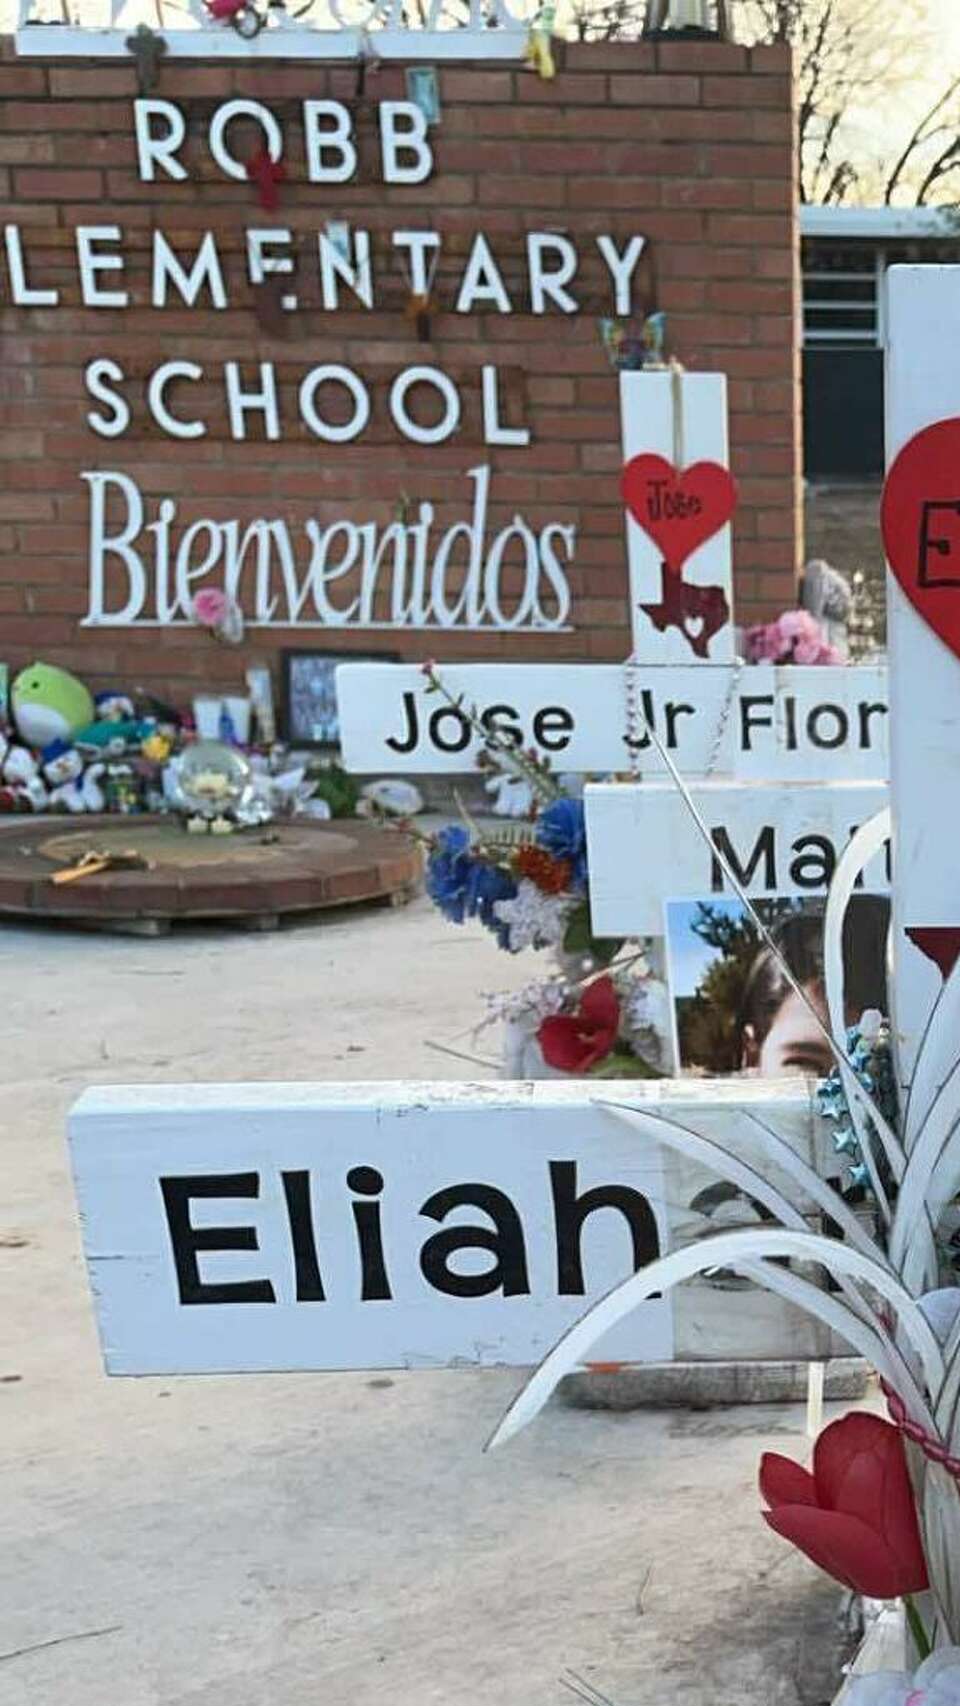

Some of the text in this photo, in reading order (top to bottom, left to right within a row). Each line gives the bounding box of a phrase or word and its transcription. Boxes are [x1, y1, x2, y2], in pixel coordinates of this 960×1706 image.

[134, 98, 434, 184] ROBB
[84, 359, 531, 446] SCHOOL
[79, 464, 576, 632] Bienvenidos
[386, 692, 575, 754] Jose
[622, 689, 696, 749] Jr
